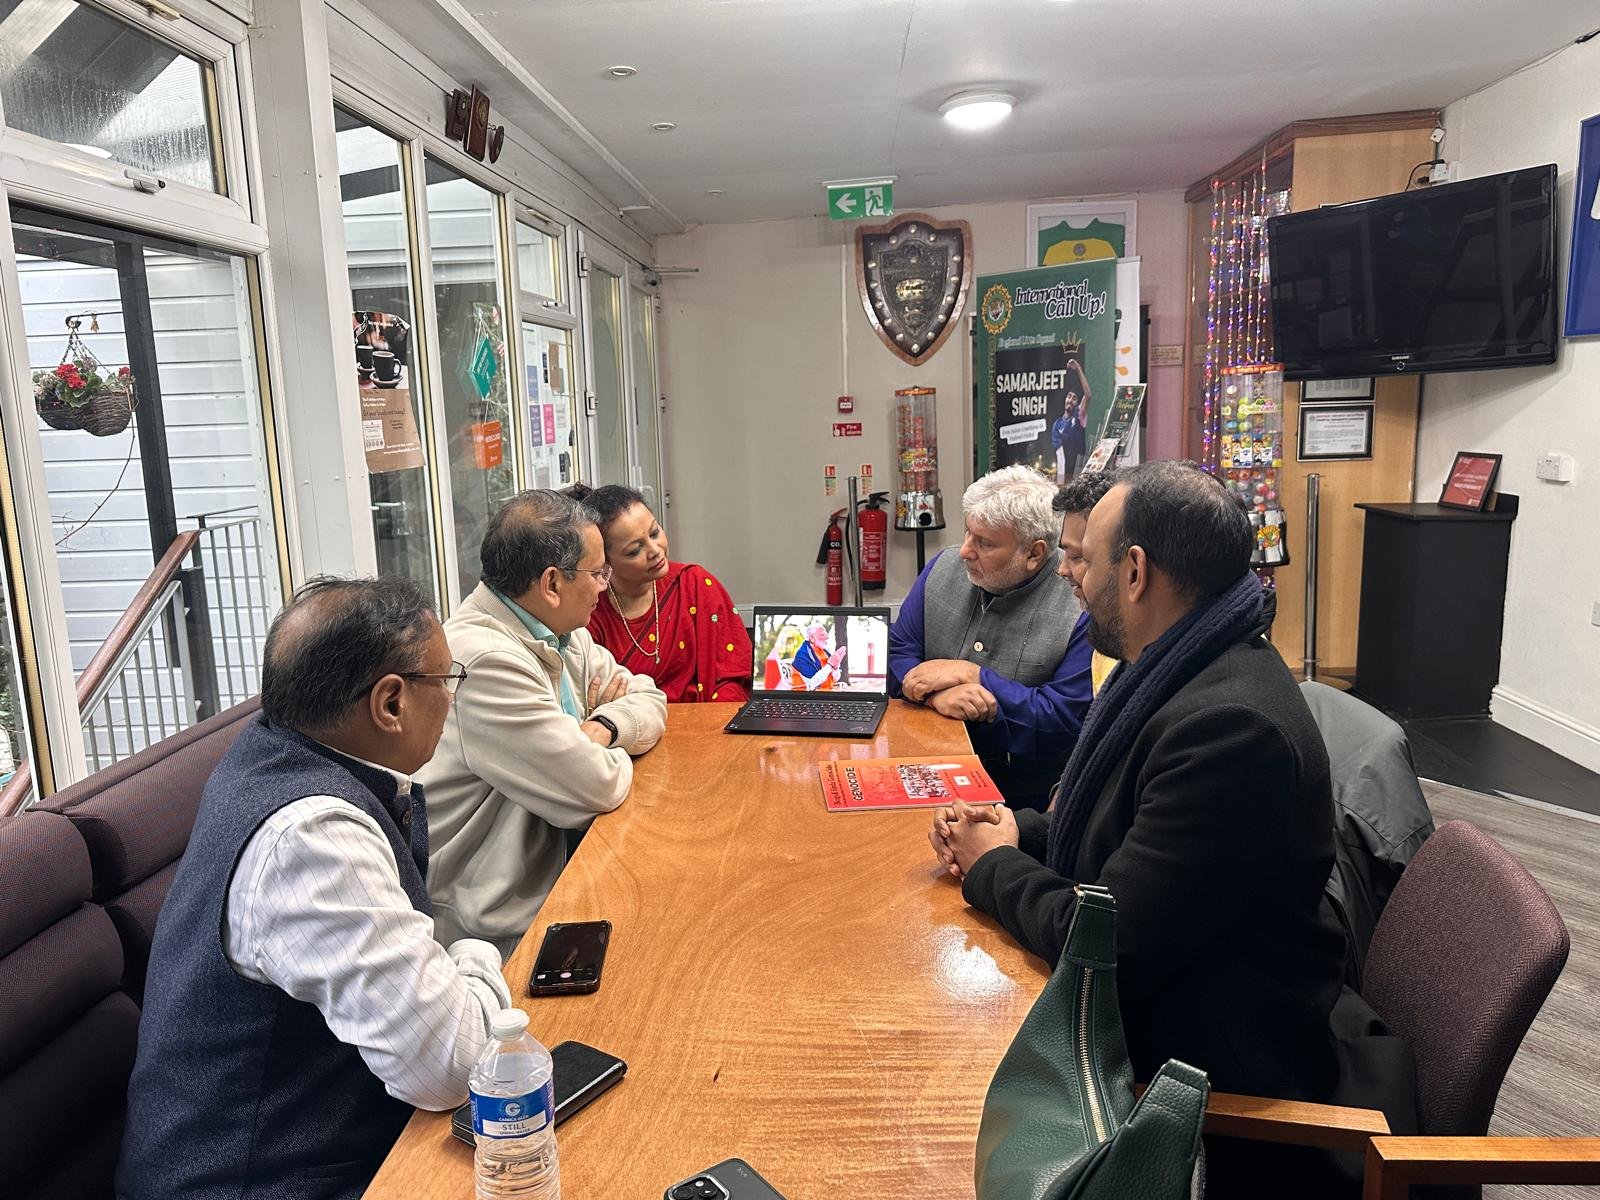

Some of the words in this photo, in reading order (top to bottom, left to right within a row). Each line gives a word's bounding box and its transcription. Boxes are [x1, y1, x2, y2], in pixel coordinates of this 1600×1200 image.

[1015, 279, 1088, 306] International
[1045, 295, 1076, 320] Call
[1077, 291, 1107, 320] Up!
[996, 369, 1067, 393] SAMARJEET
[1011, 395, 1047, 417] SINGH
[845, 767, 864, 801] GENOCIDE
[502, 1122, 526, 1131] STILL
